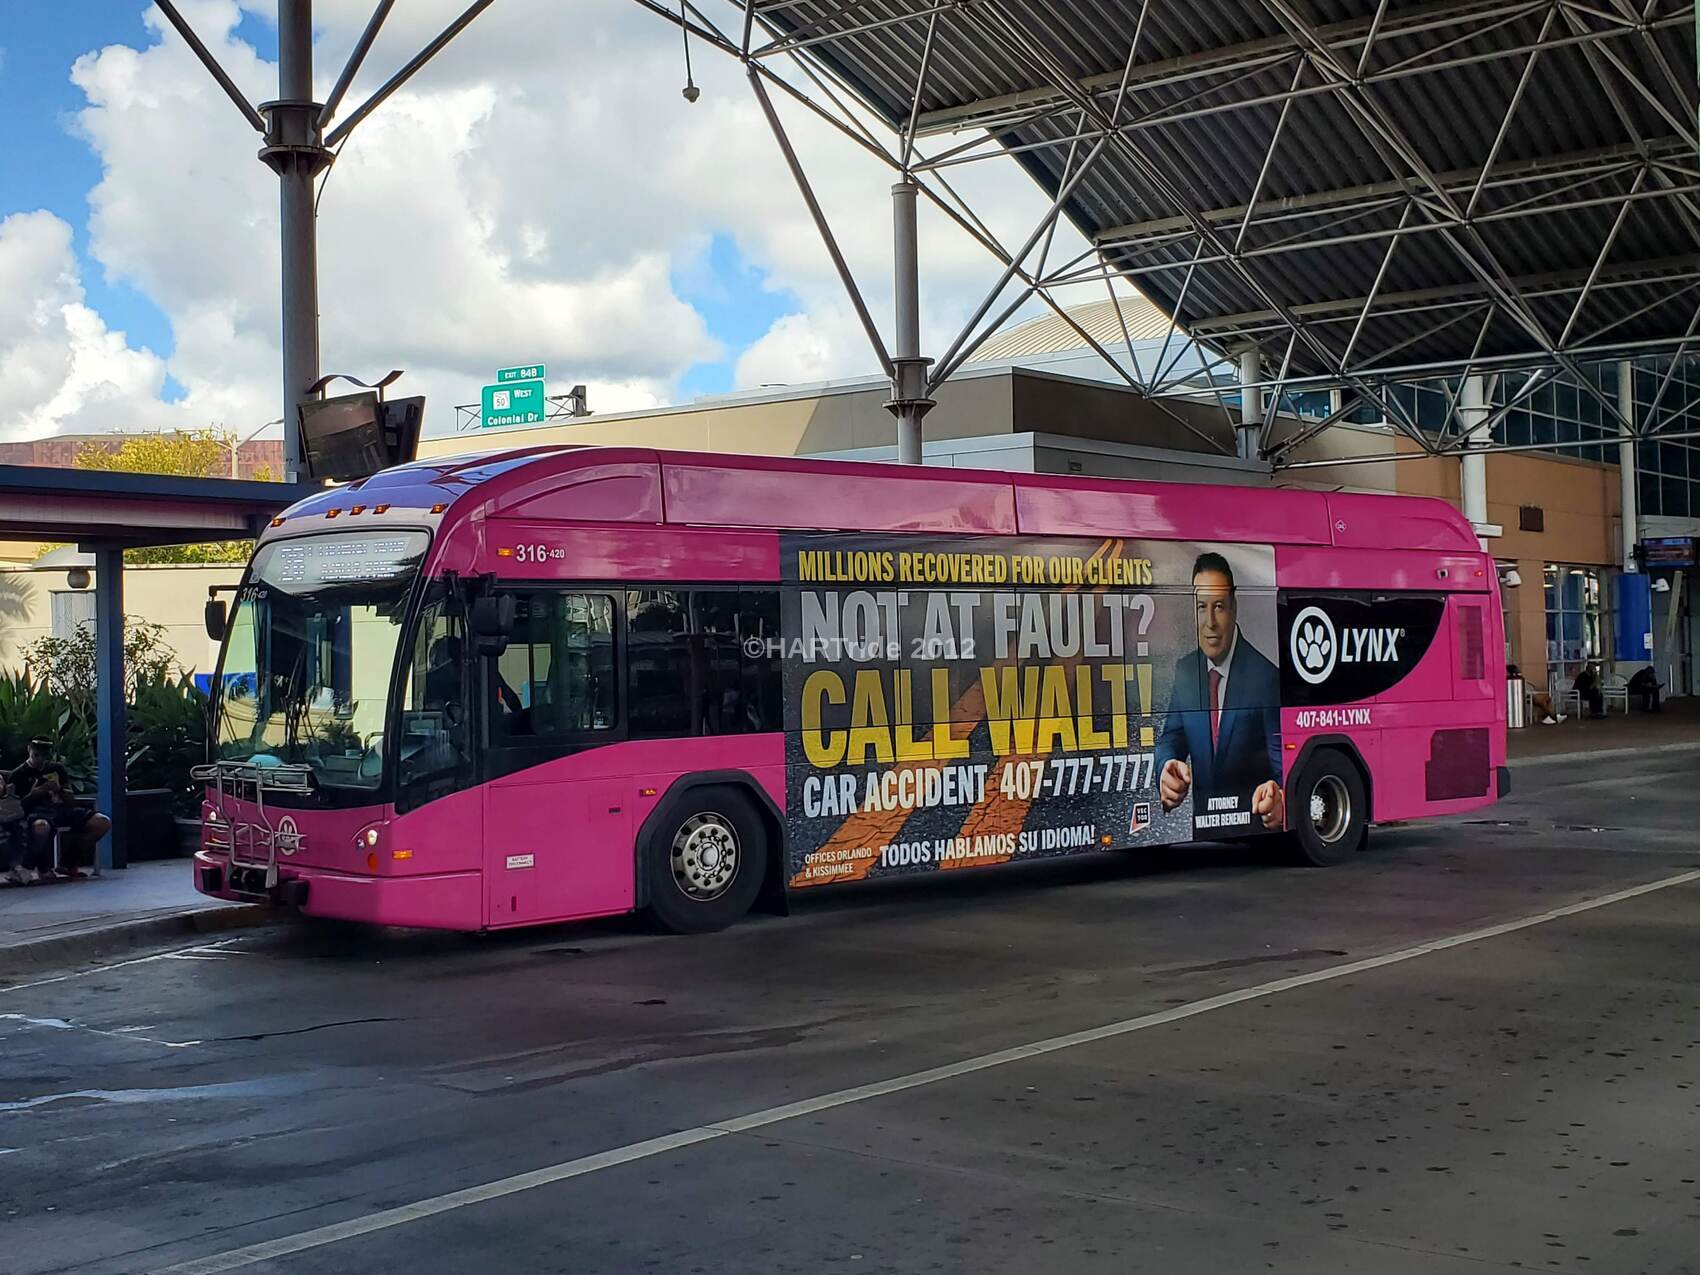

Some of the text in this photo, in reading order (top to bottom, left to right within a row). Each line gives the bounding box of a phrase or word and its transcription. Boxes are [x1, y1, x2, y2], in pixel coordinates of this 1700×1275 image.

[520, 368, 537, 378] 84B
[496, 398, 506, 406] 50
[513, 389, 532, 398] WEST
[487, 412, 539, 425] Colonial Dr
[516, 544, 565, 562] 316-420
[799, 550, 1153, 585] MILLIONS RECOVERED FOR OUR CLIENTS
[801, 590, 1156, 663] NOT AT FAULT?
[801, 664, 1155, 769] CALL WALT!
[803, 753, 1155, 818] CAR ACCIDENT 407-777-7777
[1207, 796, 1240, 811] ATTORNEY
[1195, 814, 1220, 829] WALTER
[880, 824, 1096, 867] TODOS HABLAMOS SU IDIOMA!
[805, 847, 872, 864] OFFICES ORLANDO
[805, 862, 854, 879] & KISSIMMEE
